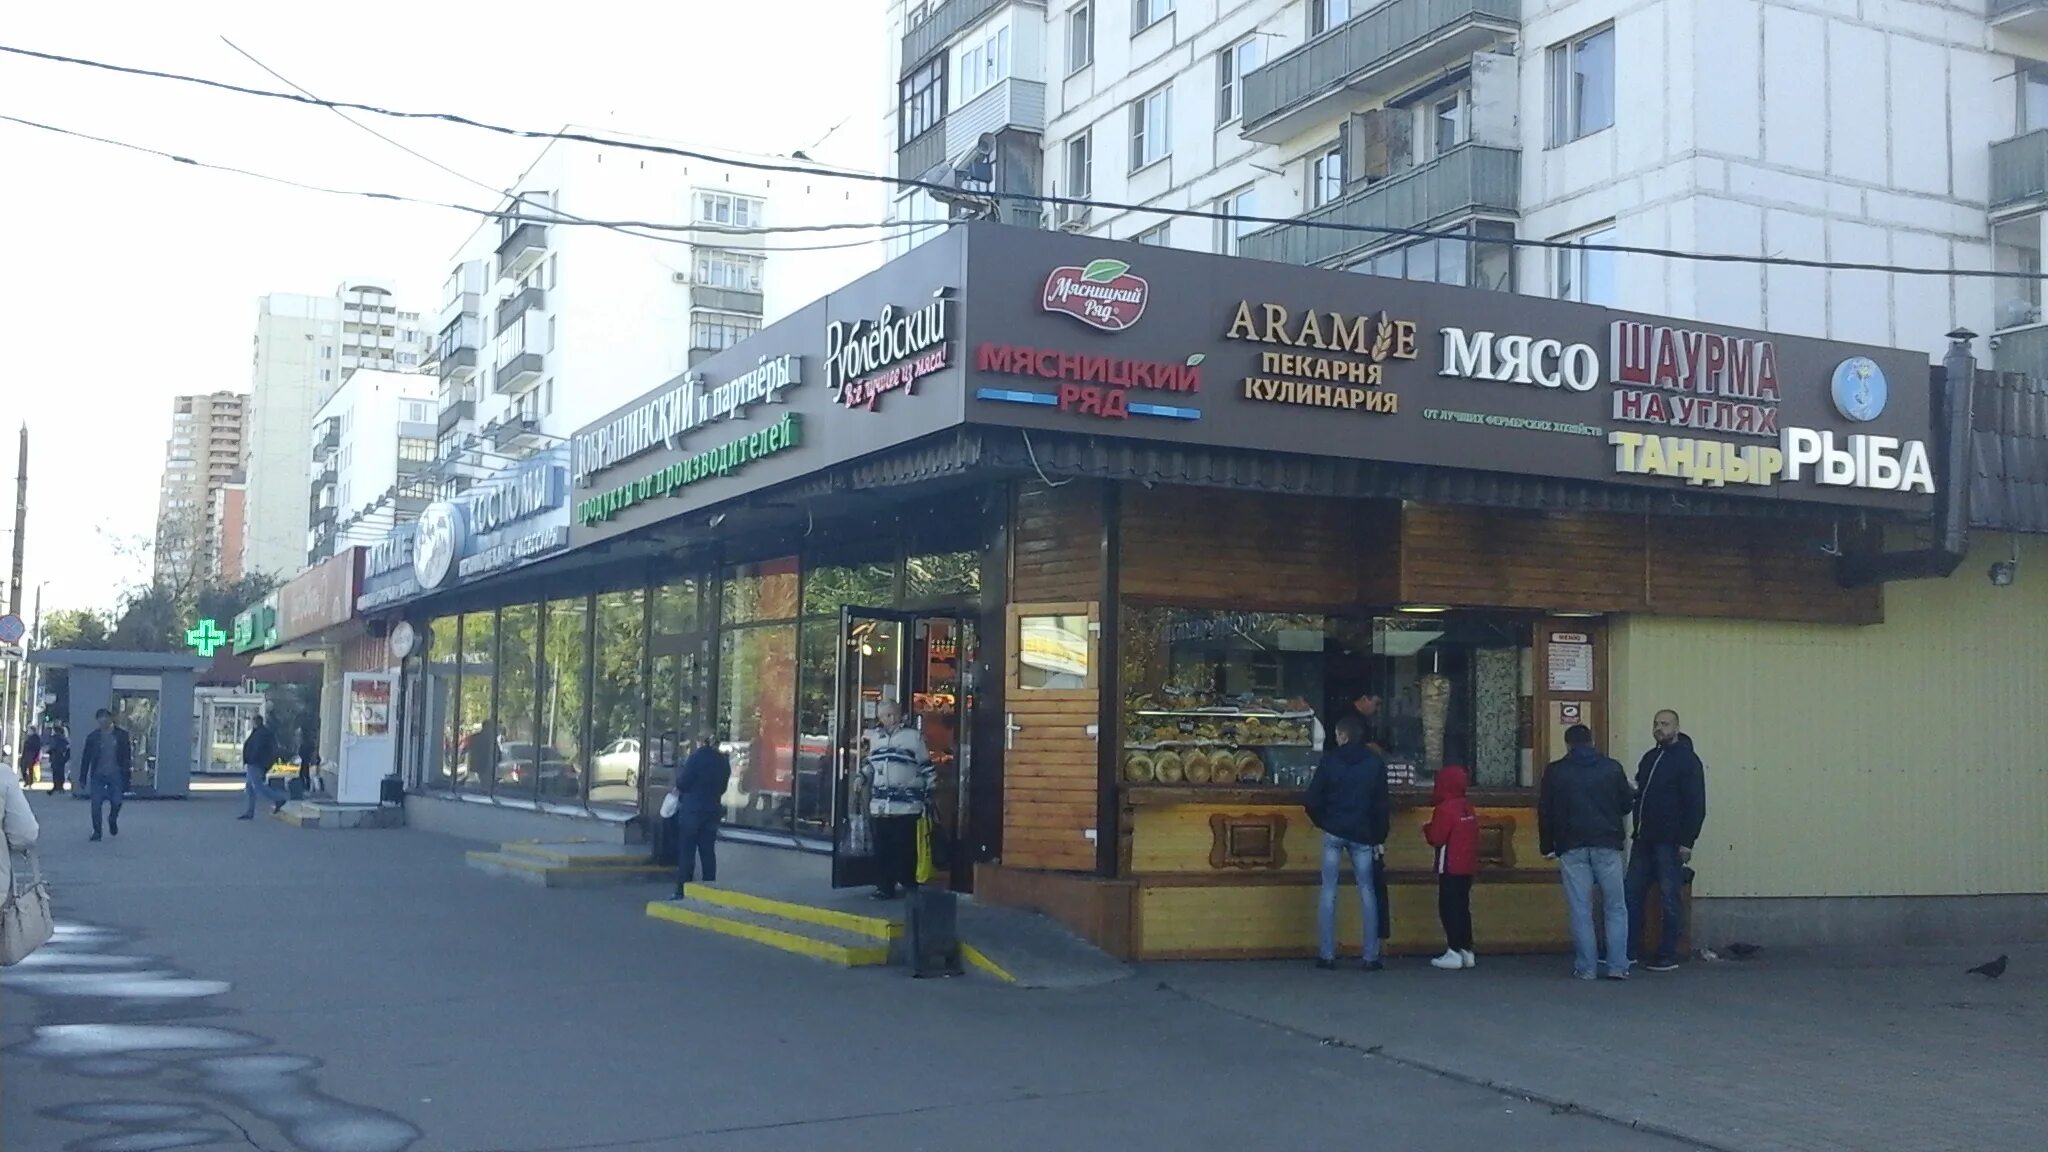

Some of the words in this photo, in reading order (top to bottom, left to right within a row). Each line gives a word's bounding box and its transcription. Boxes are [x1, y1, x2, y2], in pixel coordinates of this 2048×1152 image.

[1048, 277, 1143, 303] Мясницкий
[1085, 299, 1112, 322] Ряд
[824, 286, 946, 403] Рублёвский
[1262, 352, 1382, 385] ПЕКАРНЯ
[1438, 327, 1599, 391] МЯСО
[1611, 320, 1780, 401] ШАУРМА
[574, 371, 694, 487] ДОБРЫНИНСКИЙ
[698, 394, 711, 424] и
[713, 354, 791, 419] партнёры
[1059, 383, 1129, 419] РЯД
[1245, 377, 1398, 413] КУЛИНАРИЯ
[1424, 408, 1438, 420] ОТ
[1440, 409, 1485, 424] ЛУЧШИХ
[1614, 389, 1665, 423] НА
[1670, 396, 1777, 436] УГЛЯХ
[577, 481, 633, 527] продукты
[638, 475, 653, 499] от
[656, 411, 792, 498] производителей
[1609, 431, 1782, 487] ТАНДЫР
[1781, 427, 1935, 493] РЫБА
